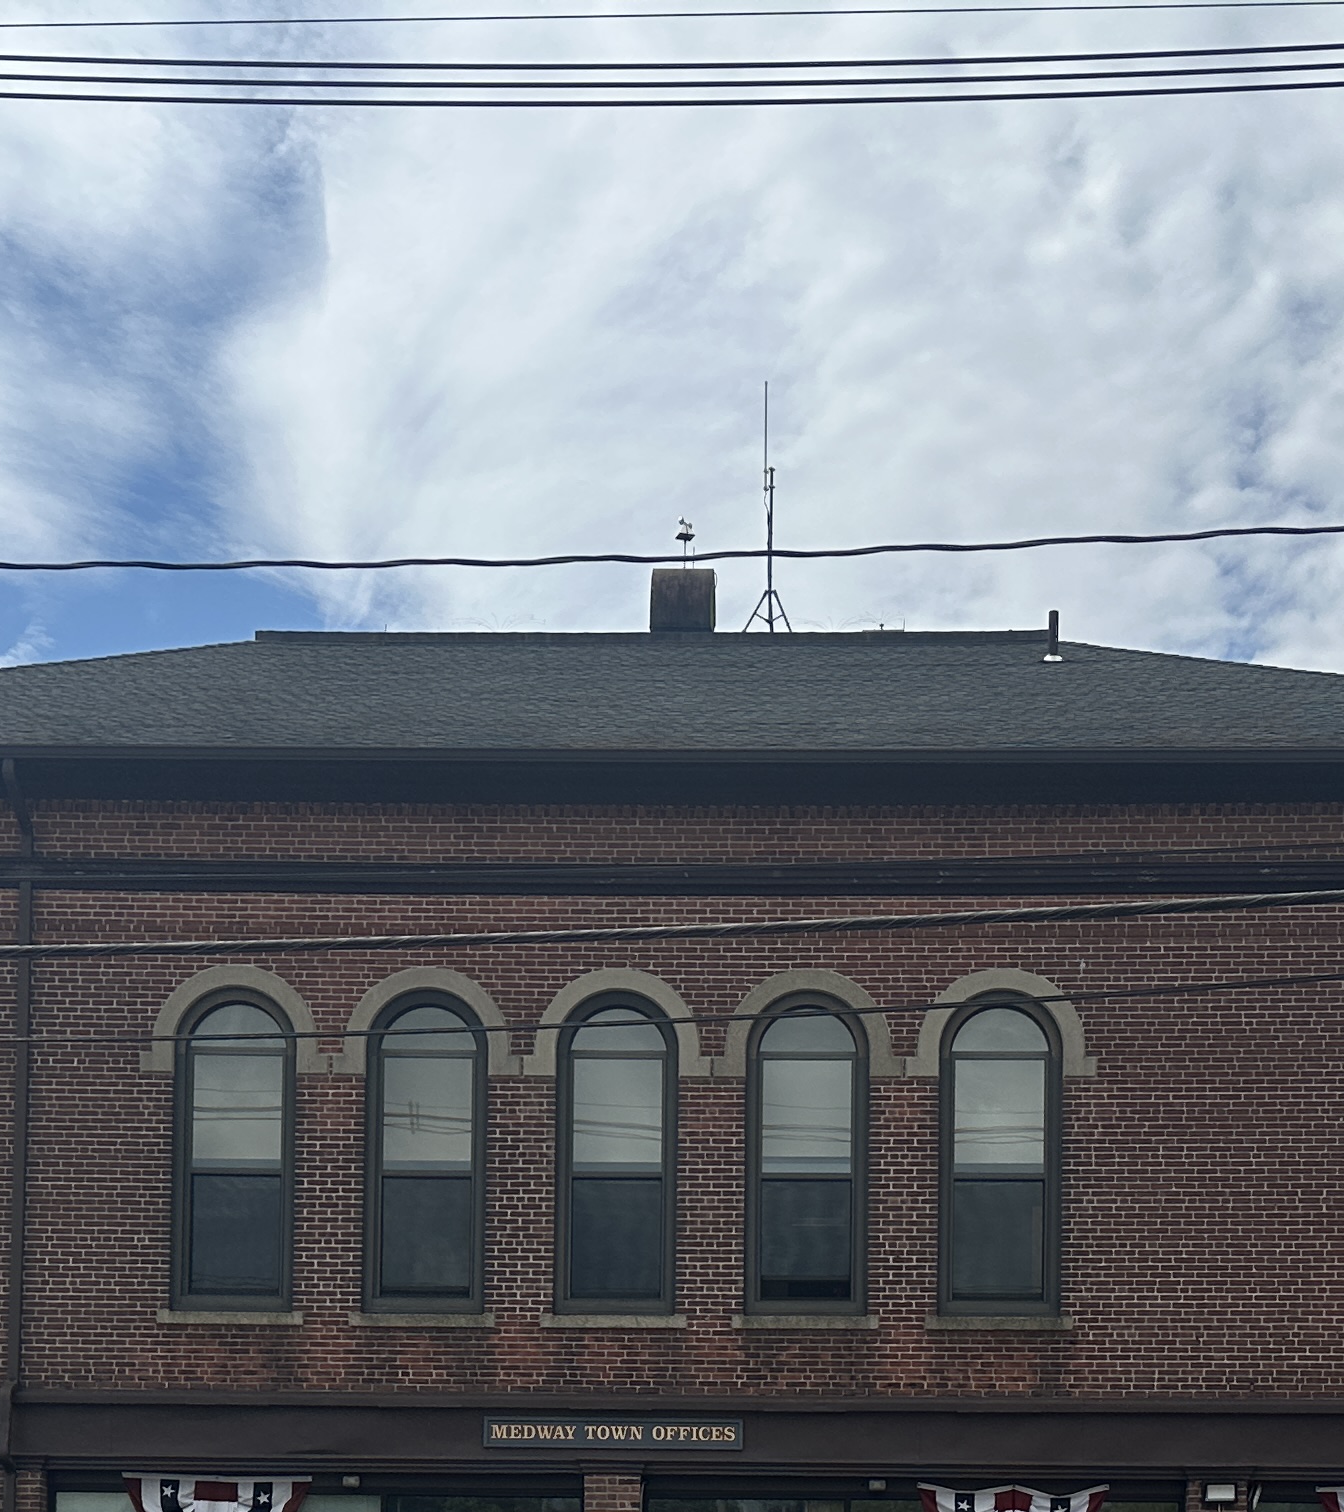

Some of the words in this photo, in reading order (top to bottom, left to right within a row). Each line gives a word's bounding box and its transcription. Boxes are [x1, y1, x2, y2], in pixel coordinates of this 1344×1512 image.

[490, 1424, 577, 1440] MEDWAY
[584, 1425, 644, 1441] TOWN
[652, 1426, 736, 1441] OFFICES
